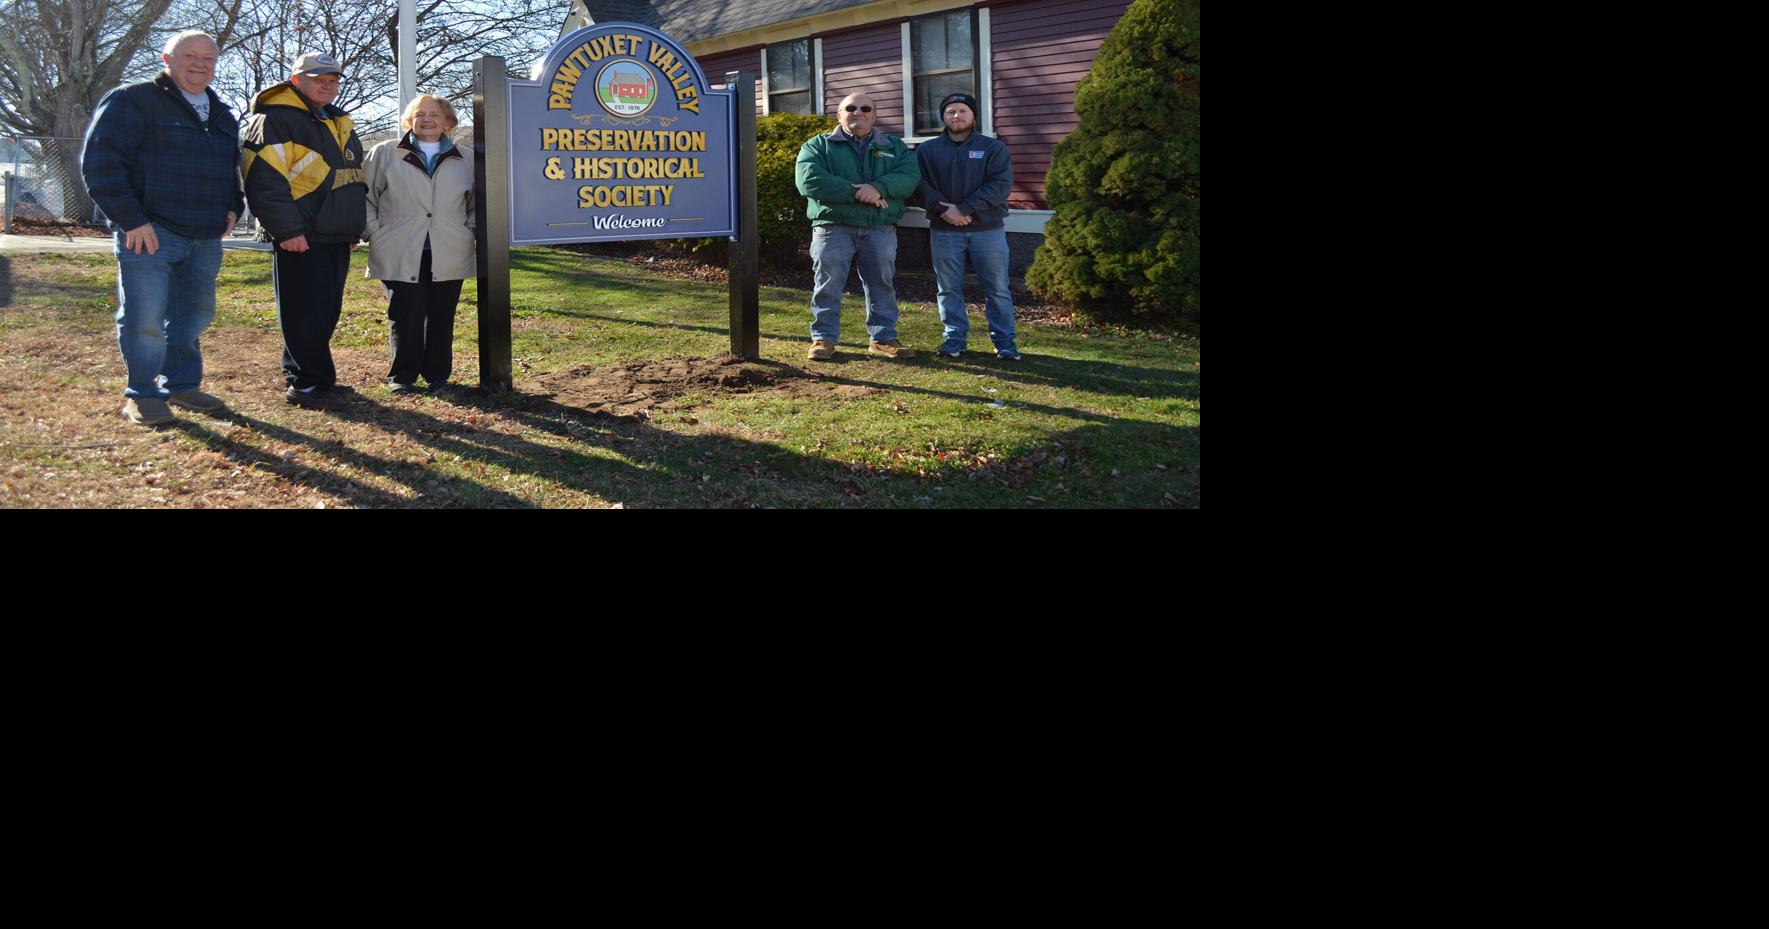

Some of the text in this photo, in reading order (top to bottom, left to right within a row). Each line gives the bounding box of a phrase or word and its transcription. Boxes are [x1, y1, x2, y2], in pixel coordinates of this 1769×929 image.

[549, 34, 700, 114] PAWTUXET VALLEY
[541, 128, 706, 151] PRESERVATION
[545, 157, 705, 180] & HISTORICAL
[577, 185, 674, 208] SOCIETY
[593, 213, 665, 230] Welcome
